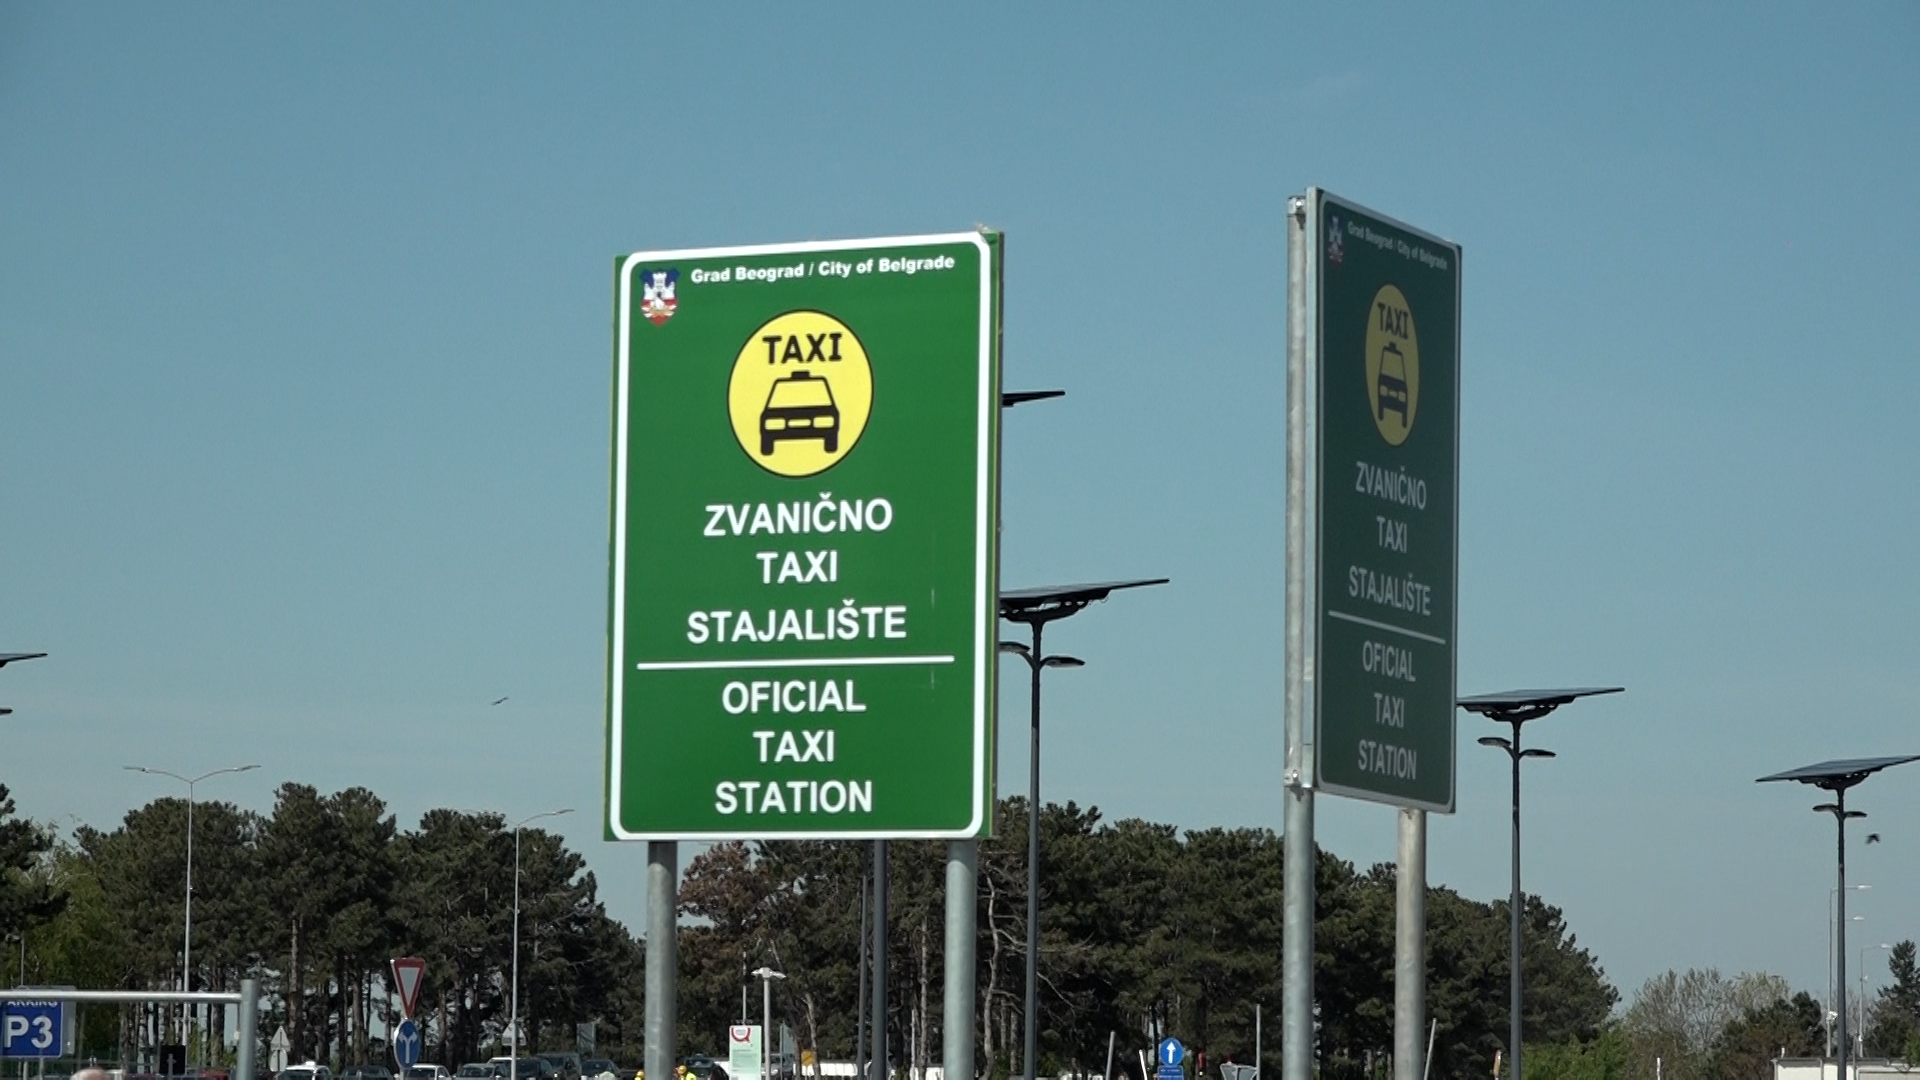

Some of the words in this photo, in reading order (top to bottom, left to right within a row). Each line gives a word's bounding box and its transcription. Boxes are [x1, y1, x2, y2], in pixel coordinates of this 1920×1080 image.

[691, 269, 730, 283] Grad
[735, 263, 804, 283] Beograd
[808, 261, 814, 276] /
[818, 260, 851, 279] City
[856, 259, 873, 274] of
[878, 255, 955, 275] Belgrade
[1377, 302, 1408, 339] TAXI
[762, 332, 842, 365] TAXI
[1355, 461, 1427, 510] ZVANIČNO
[703, 491, 893, 537] ZVANIČNO
[1376, 515, 1407, 553] TAXI
[755, 549, 838, 585] TAXI
[1349, 565, 1431, 616] STAJALIŠTE
[686, 598, 907, 644] STAJALIŠTE
[1362, 640, 1416, 682] OFICIAL
[721, 679, 867, 715] OFICIAL
[1374, 693, 1404, 728] TAXI
[752, 729, 835, 763] TAXI
[1358, 739, 1417, 780] STATION
[714, 779, 873, 815] STATION
[4, 1014, 53, 1049] P3
